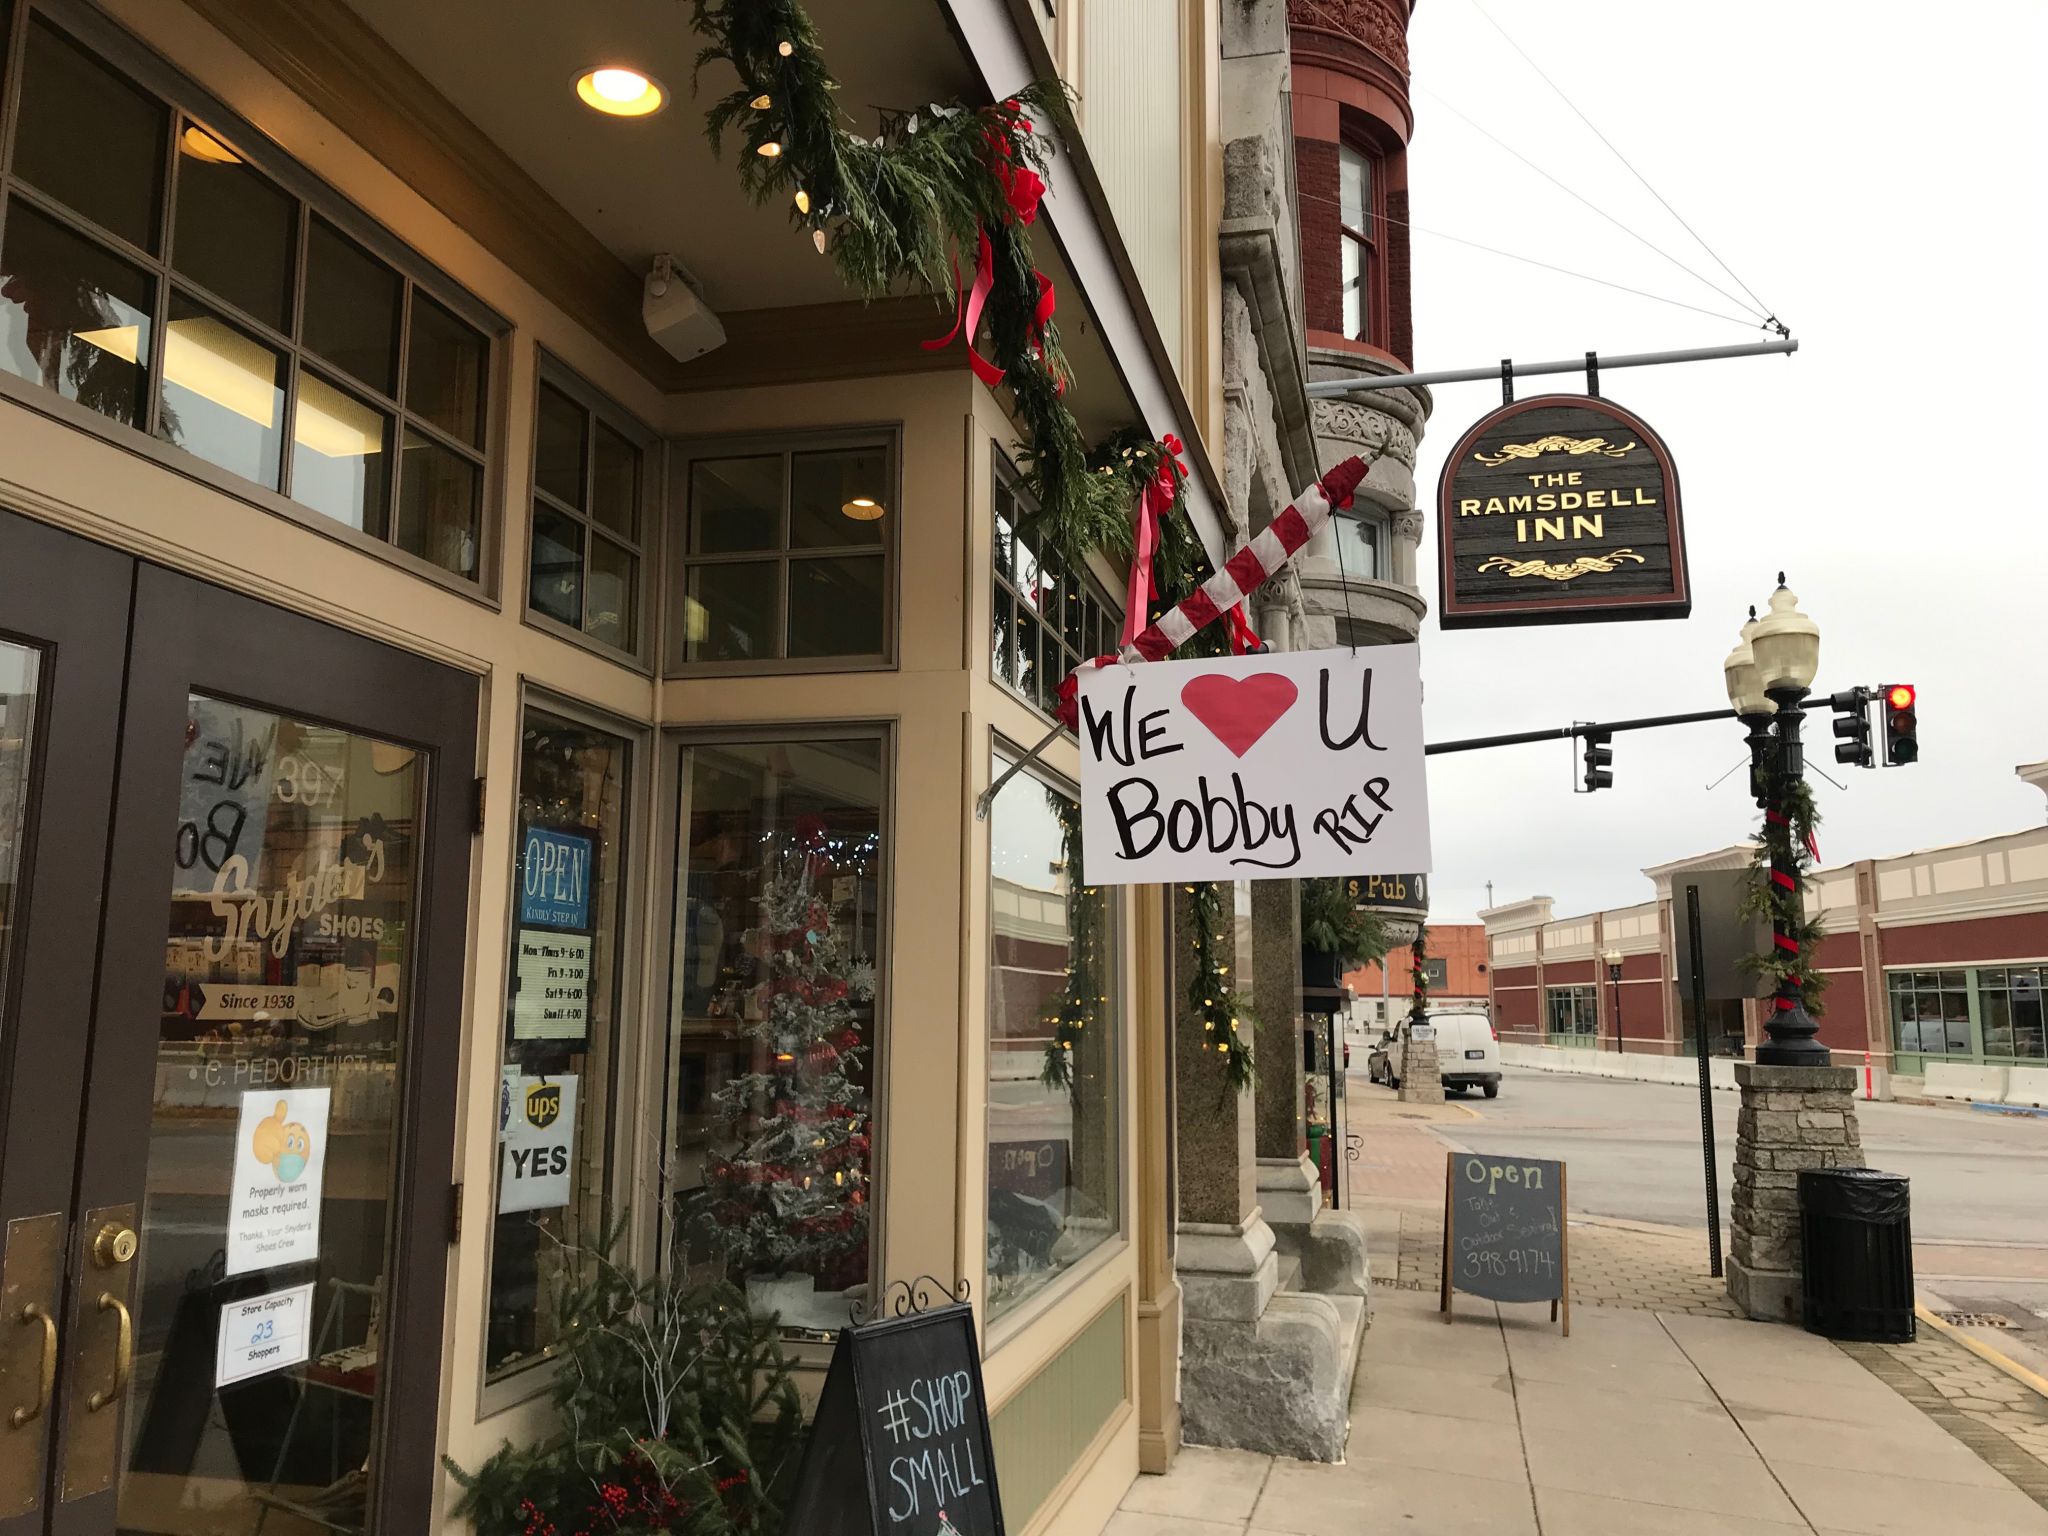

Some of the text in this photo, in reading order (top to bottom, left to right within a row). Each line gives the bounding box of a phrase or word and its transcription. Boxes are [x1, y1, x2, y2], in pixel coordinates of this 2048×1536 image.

[1528, 471, 1583, 489] THE
[1460, 487, 1656, 517] RAMSDELL
[1516, 514, 1604, 543] INN
[1081, 668, 1388, 767] WE U
[276, 755, 346, 809] 397
[1106, 772, 1394, 869] Bobby RIP
[525, 838, 585, 904] OPEN
[203, 833, 385, 963] Snyder's
[1367, 874, 1406, 900] Pub
[319, 913, 385, 939] SHOES
[526, 906, 579, 925] KINDLY STEP IN
[547, 967, 558, 977] Fri
[219, 993, 295, 1009] Since 1938
[545, 988, 557, 999] Sat
[543, 1008, 557, 1019] Sun
[528, 1096, 559, 1123] ups
[510, 1145, 568, 1180] YES
[1465, 1159, 1543, 1195] Open
[249, 1182, 308, 1199] Properly worn
[242, 1199, 310, 1219] masks required.
[266, 1227, 283, 1238] Your
[284, 1221, 312, 1235] Snyder's
[255, 1239, 295, 1253] Shoes Crew
[1463, 1249, 1555, 1278] 398-9174
[241, 1297, 294, 1316] Store Capacity
[251, 1319, 274, 1344] 23
[247, 1345, 281, 1361] Shoppers
[877, 1370, 971, 1444] #SHOP
[888, 1438, 985, 1522] SMALL
